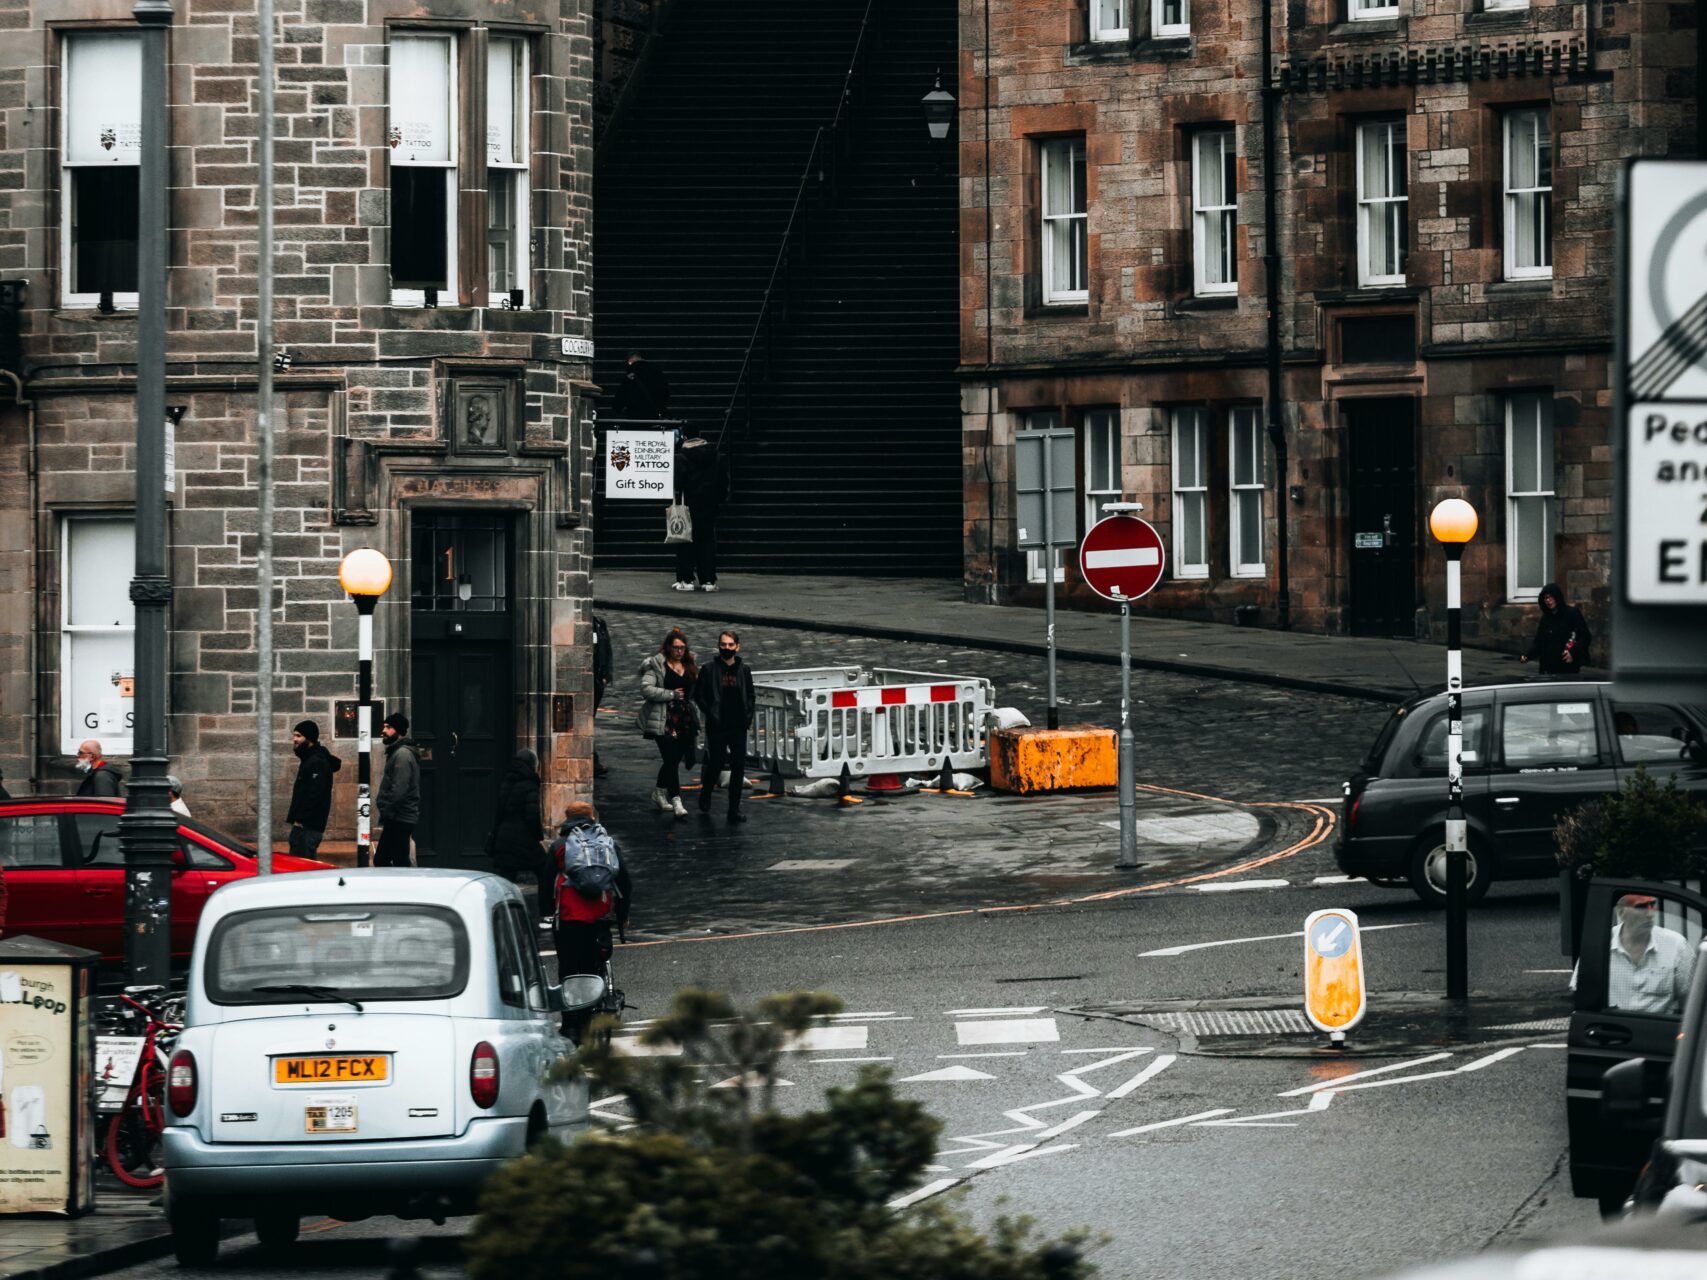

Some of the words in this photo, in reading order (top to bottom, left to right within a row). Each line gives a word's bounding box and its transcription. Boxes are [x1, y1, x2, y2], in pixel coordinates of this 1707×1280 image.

[1656, 461, 1707, 483] an
[615, 479, 635, 489] Gift
[638, 479, 665, 491] Shop
[444, 546, 456, 581] 1
[287, 1060, 331, 1078] ML12
[336, 1059, 375, 1077] FCX
[329, 1106, 353, 1118] 1205
